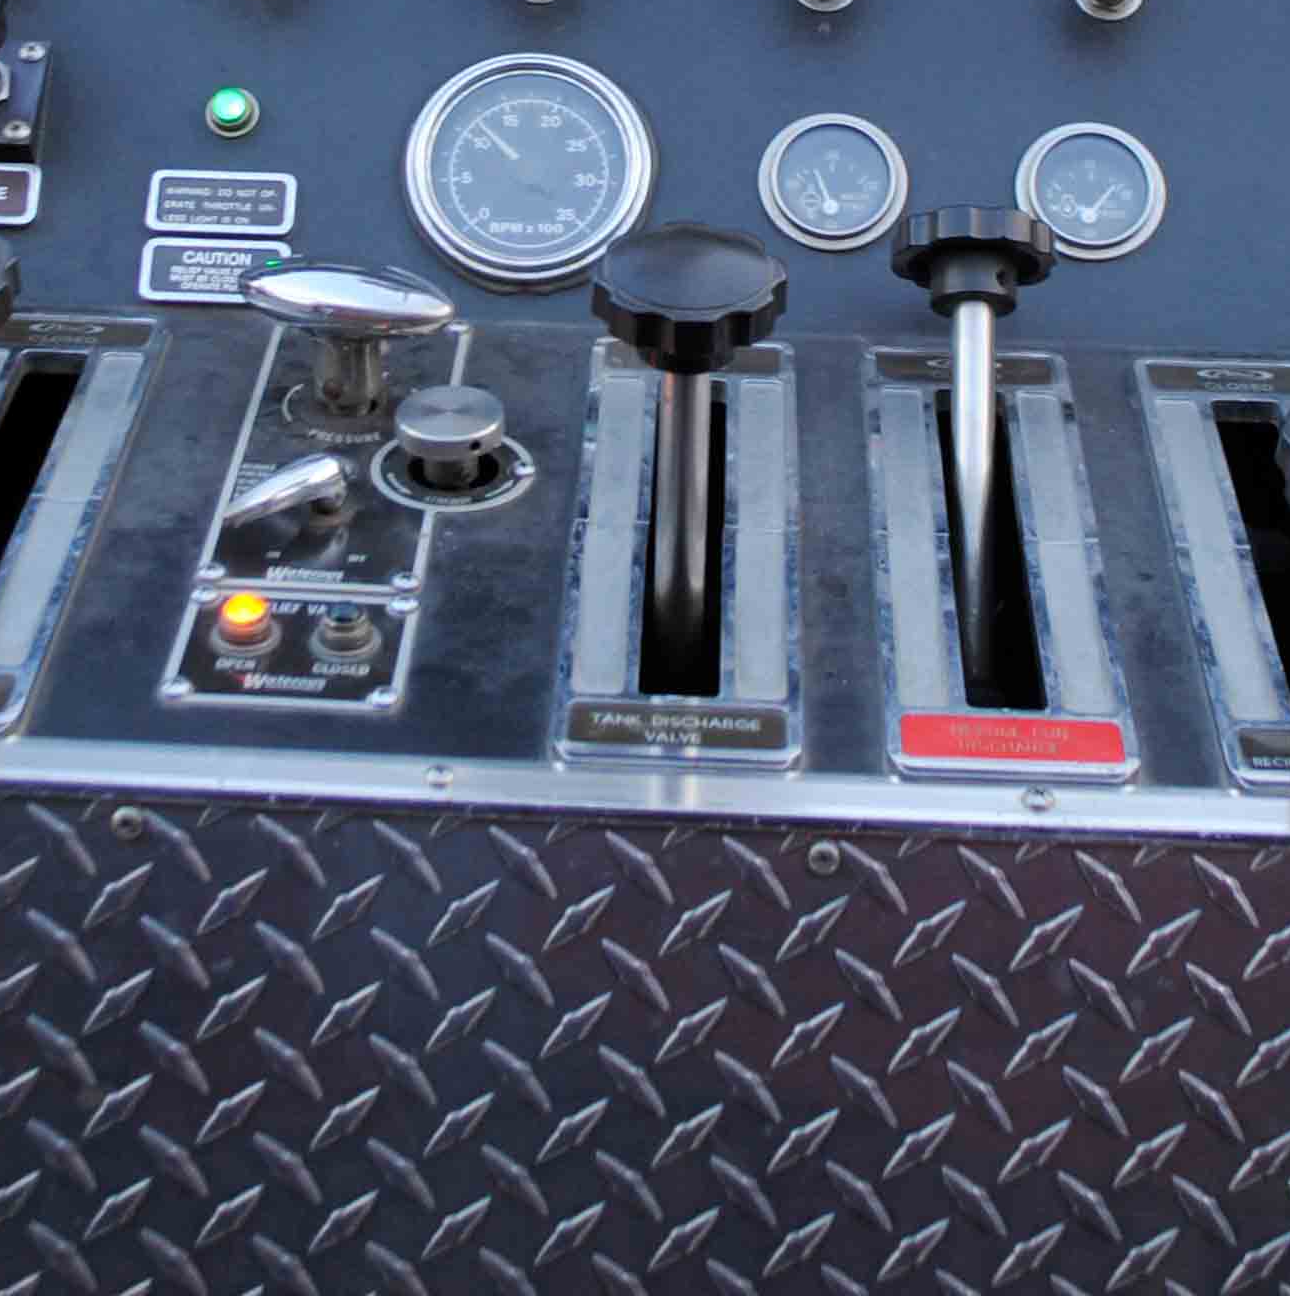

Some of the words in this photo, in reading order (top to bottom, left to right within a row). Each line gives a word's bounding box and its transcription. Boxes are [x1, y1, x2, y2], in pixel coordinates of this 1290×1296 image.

[501, 114, 519, 127] 15
[540, 114, 561, 128] 20
[565, 139, 587, 152] 25
[461, 171, 473, 184] 5
[574, 174, 597, 187] 30
[479, 207, 491, 219] 0
[556, 208, 576, 221] 35
[489, 222, 523, 233] RPM
[538, 223, 564, 233] 100
[183, 251, 252, 265] CAUTION
[312, 663, 370, 676] CLOSED
[592, 712, 642, 728] TANK
[651, 714, 760, 731] DISCHARGE
[645, 730, 701, 744] VALVE
